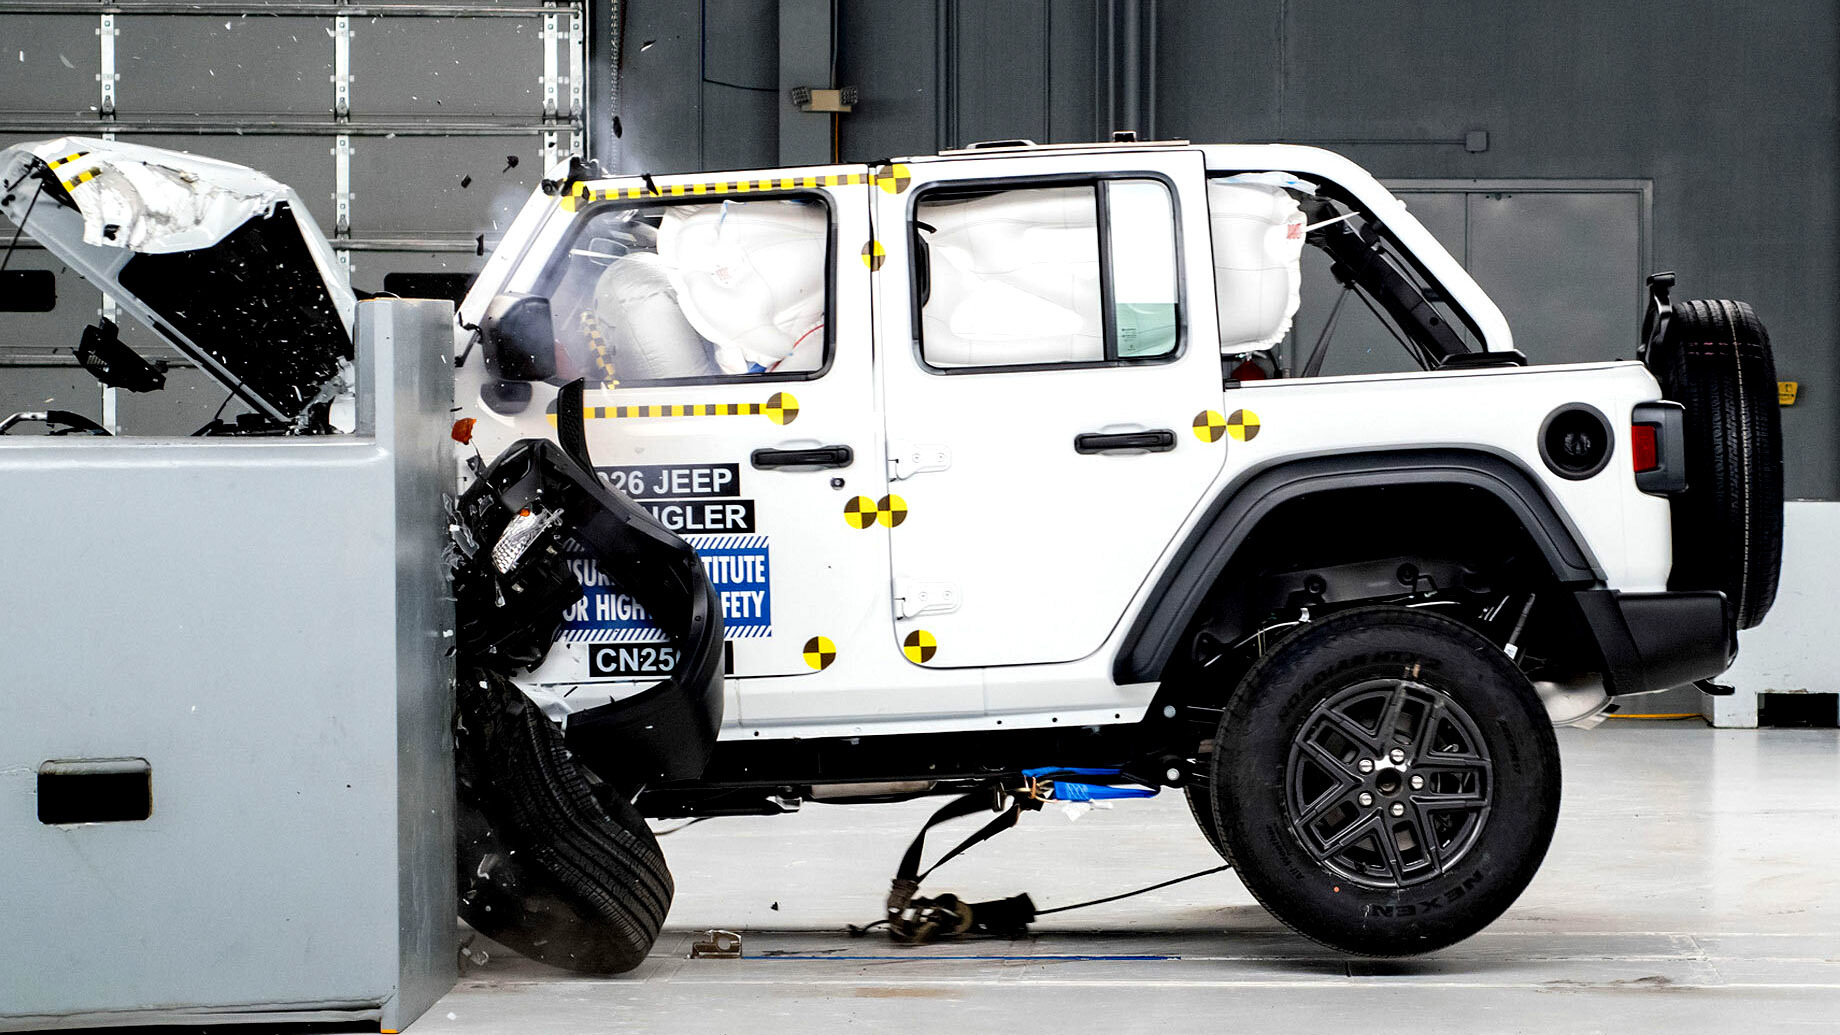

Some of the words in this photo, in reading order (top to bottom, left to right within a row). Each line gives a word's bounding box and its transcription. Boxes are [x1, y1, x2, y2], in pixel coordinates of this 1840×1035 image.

[653, 468, 733, 494] JEEP
[700, 555, 766, 584] TITUTE
[562, 594, 589, 621] OR
[596, 593, 653, 621] HIGH
[720, 591, 766, 618] FETY
[596, 648, 681, 673] CN25
[1371, 870, 1485, 918] NEXEN
